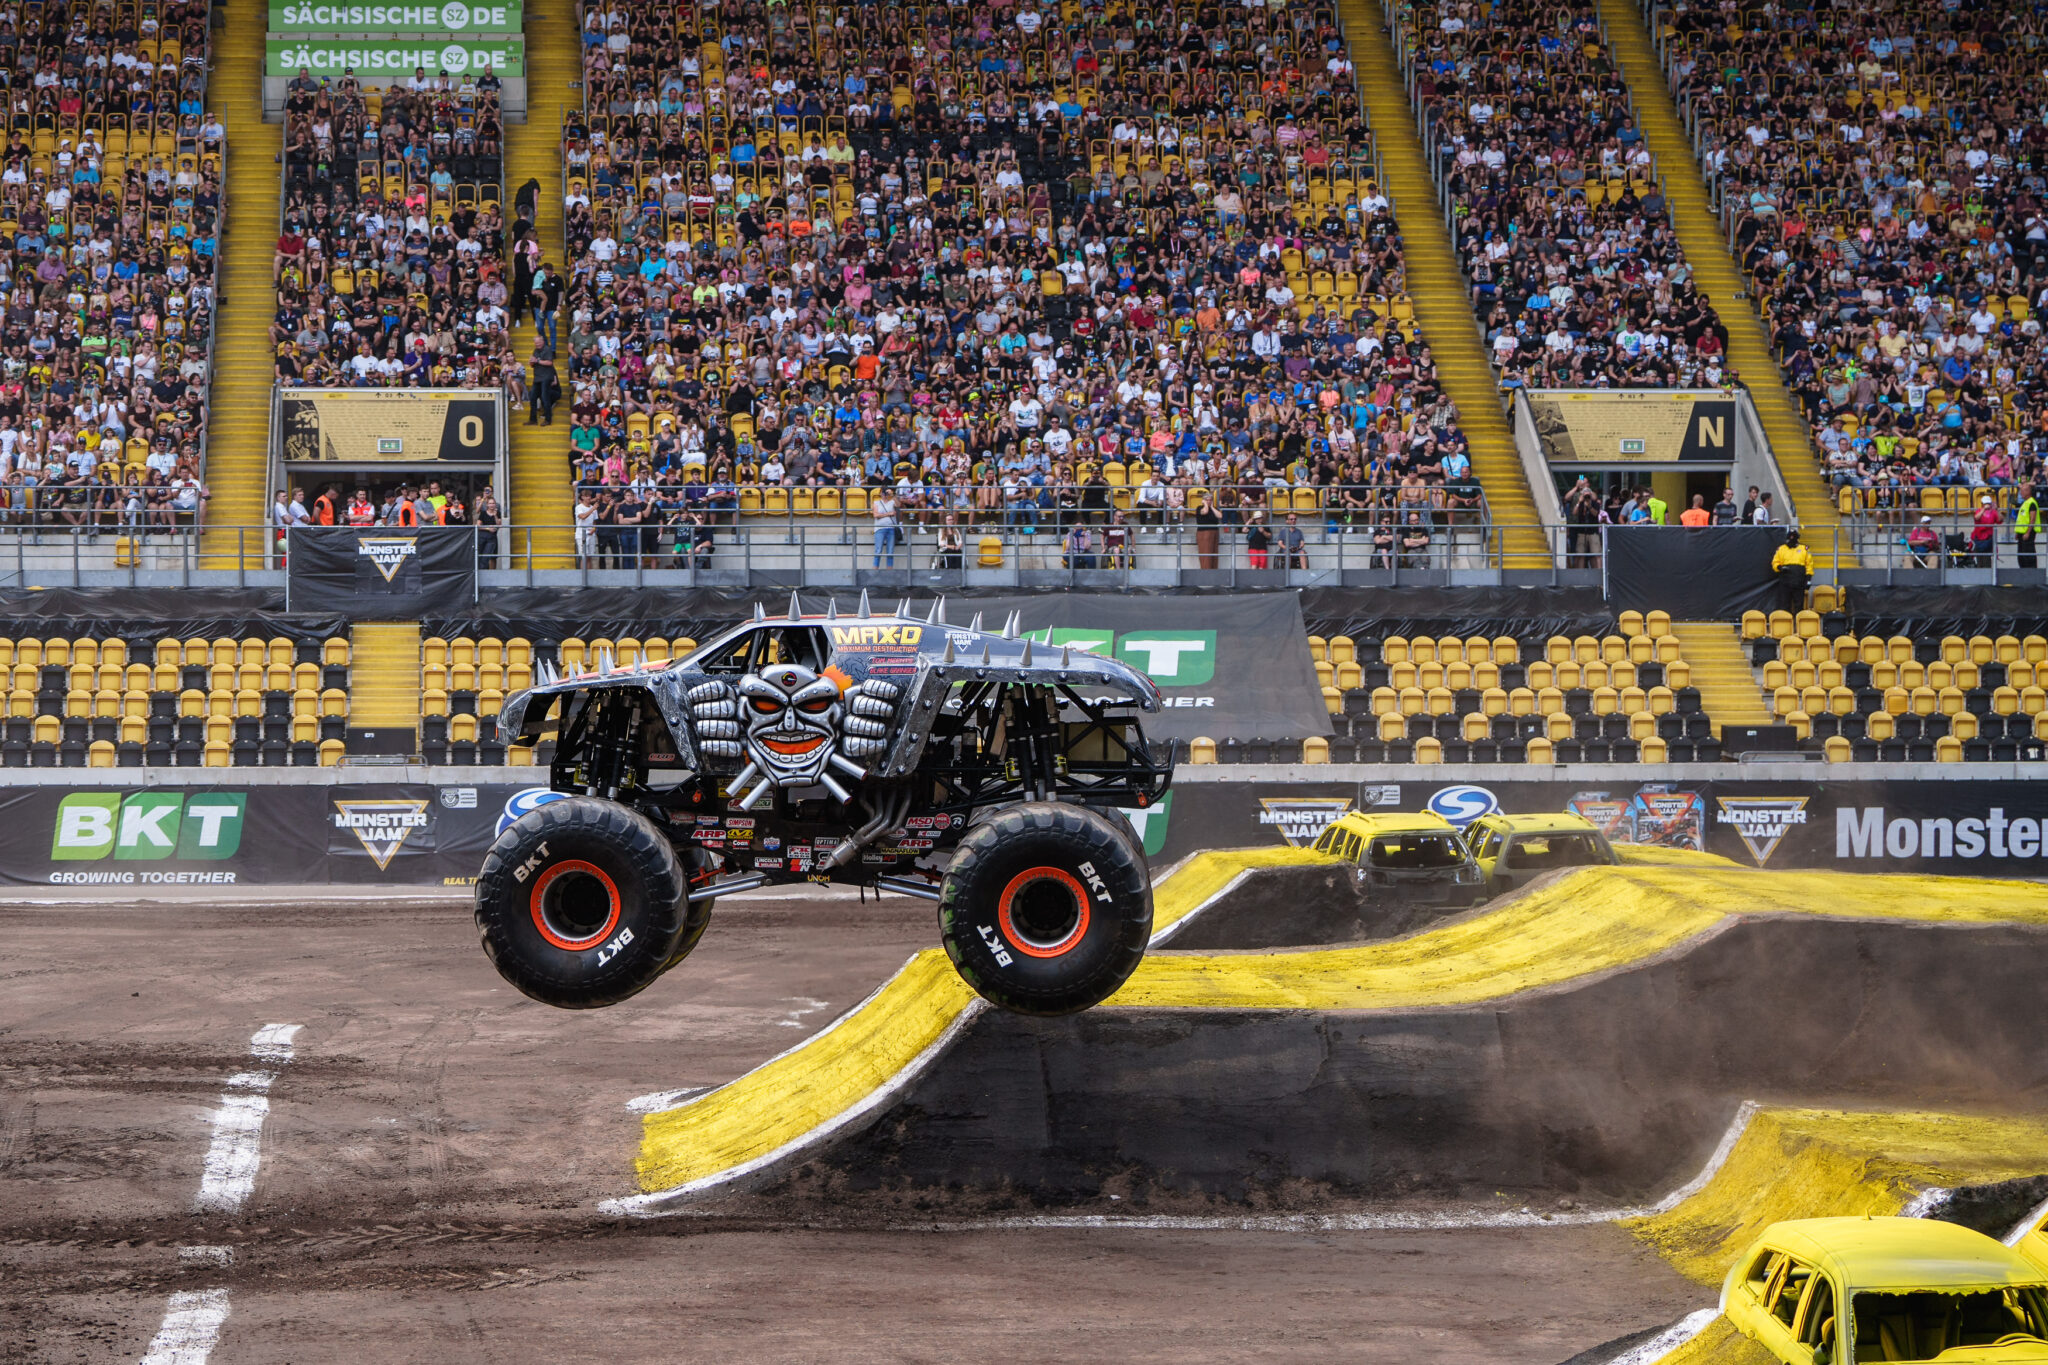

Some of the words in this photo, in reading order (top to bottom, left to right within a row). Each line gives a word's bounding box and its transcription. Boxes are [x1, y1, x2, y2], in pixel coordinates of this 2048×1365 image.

[283, 1, 437, 25] SÄCHSISCHE
[446, 9, 465, 22] SZ
[473, 7, 506, 25] DE
[280, 44, 436, 68] SÄCHSISCHE
[445, 52, 464, 65] SZ
[473, 51, 506, 68] DE
[1699, 416, 1724, 447] N
[358, 545, 417, 555] MONSTER
[376, 554, 400, 564] JAM
[832, 626, 922, 645] MAX-D
[335, 812, 428, 828] MONSTER
[908, 817, 933, 825] MSD
[1717, 809, 1807, 824] MONSTER
[58, 806, 239, 847] BKT
[361, 827, 405, 842] JAM
[1742, 824, 1784, 838] JAM
[1836, 807, 2048, 858] Monste
[513, 841, 550, 883] BKT
[49, 872, 137, 884] GROWING
[139, 872, 236, 884] TOGETHER
[443, 877, 466, 885] REAL
[1078, 861, 1113, 903] BKT
[597, 927, 635, 967] BKT
[976, 925, 1014, 968] BKT
